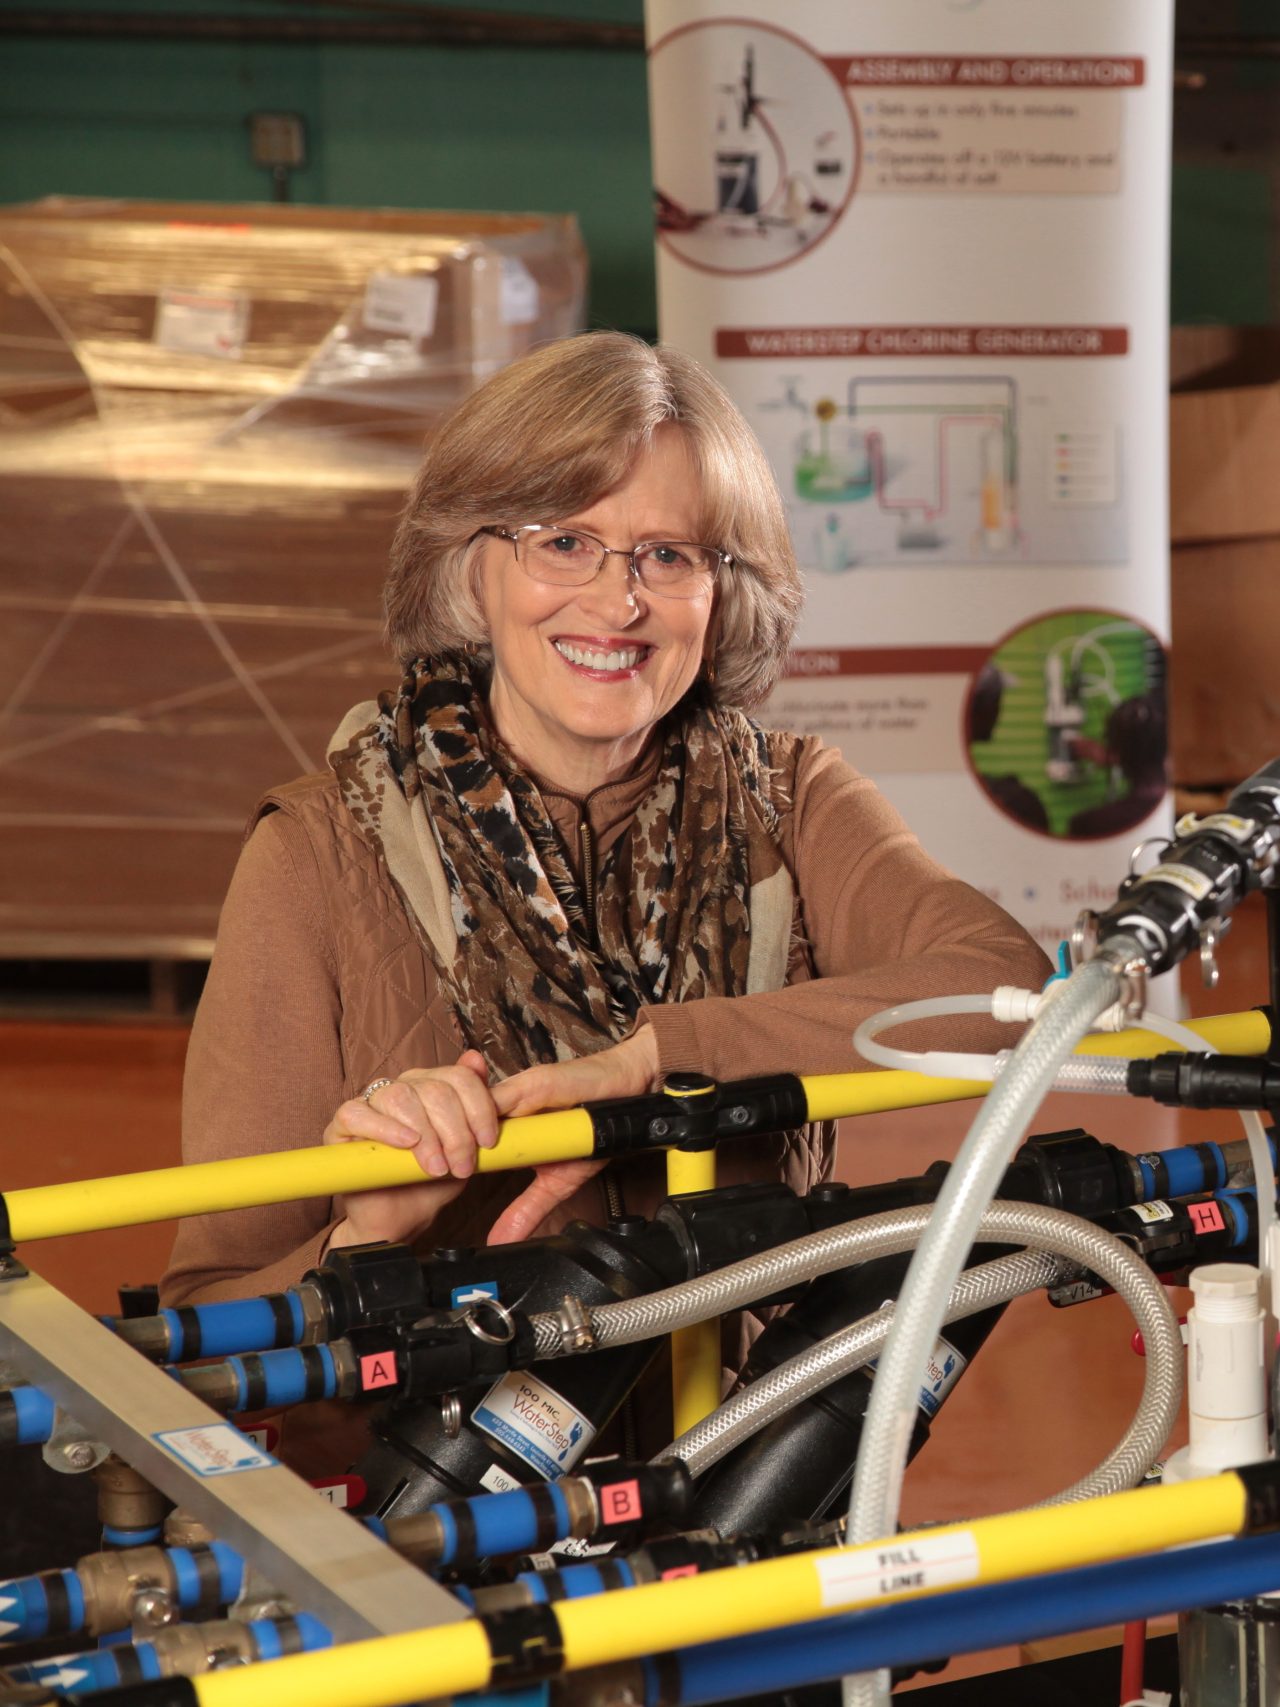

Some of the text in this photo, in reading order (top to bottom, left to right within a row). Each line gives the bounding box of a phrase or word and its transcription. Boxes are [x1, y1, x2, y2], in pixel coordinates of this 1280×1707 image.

[848, 60, 1135, 84] ASSEMBLY AND OPERATION
[866, 330, 969, 353] CHLORINE
[975, 329, 1102, 352] GENERATOR
[1198, 1207, 1217, 1229] H
[1071, 1284, 1094, 1299] V14
[371, 1360, 389, 1384] A
[520, 1384, 540, 1403] 100
[513, 1393, 569, 1450] WaterStep
[493, 1475, 509, 1492] 100
[612, 1490, 631, 1515] B
[878, 1549, 920, 1568] FILL
[880, 1571, 925, 1593] LINE
